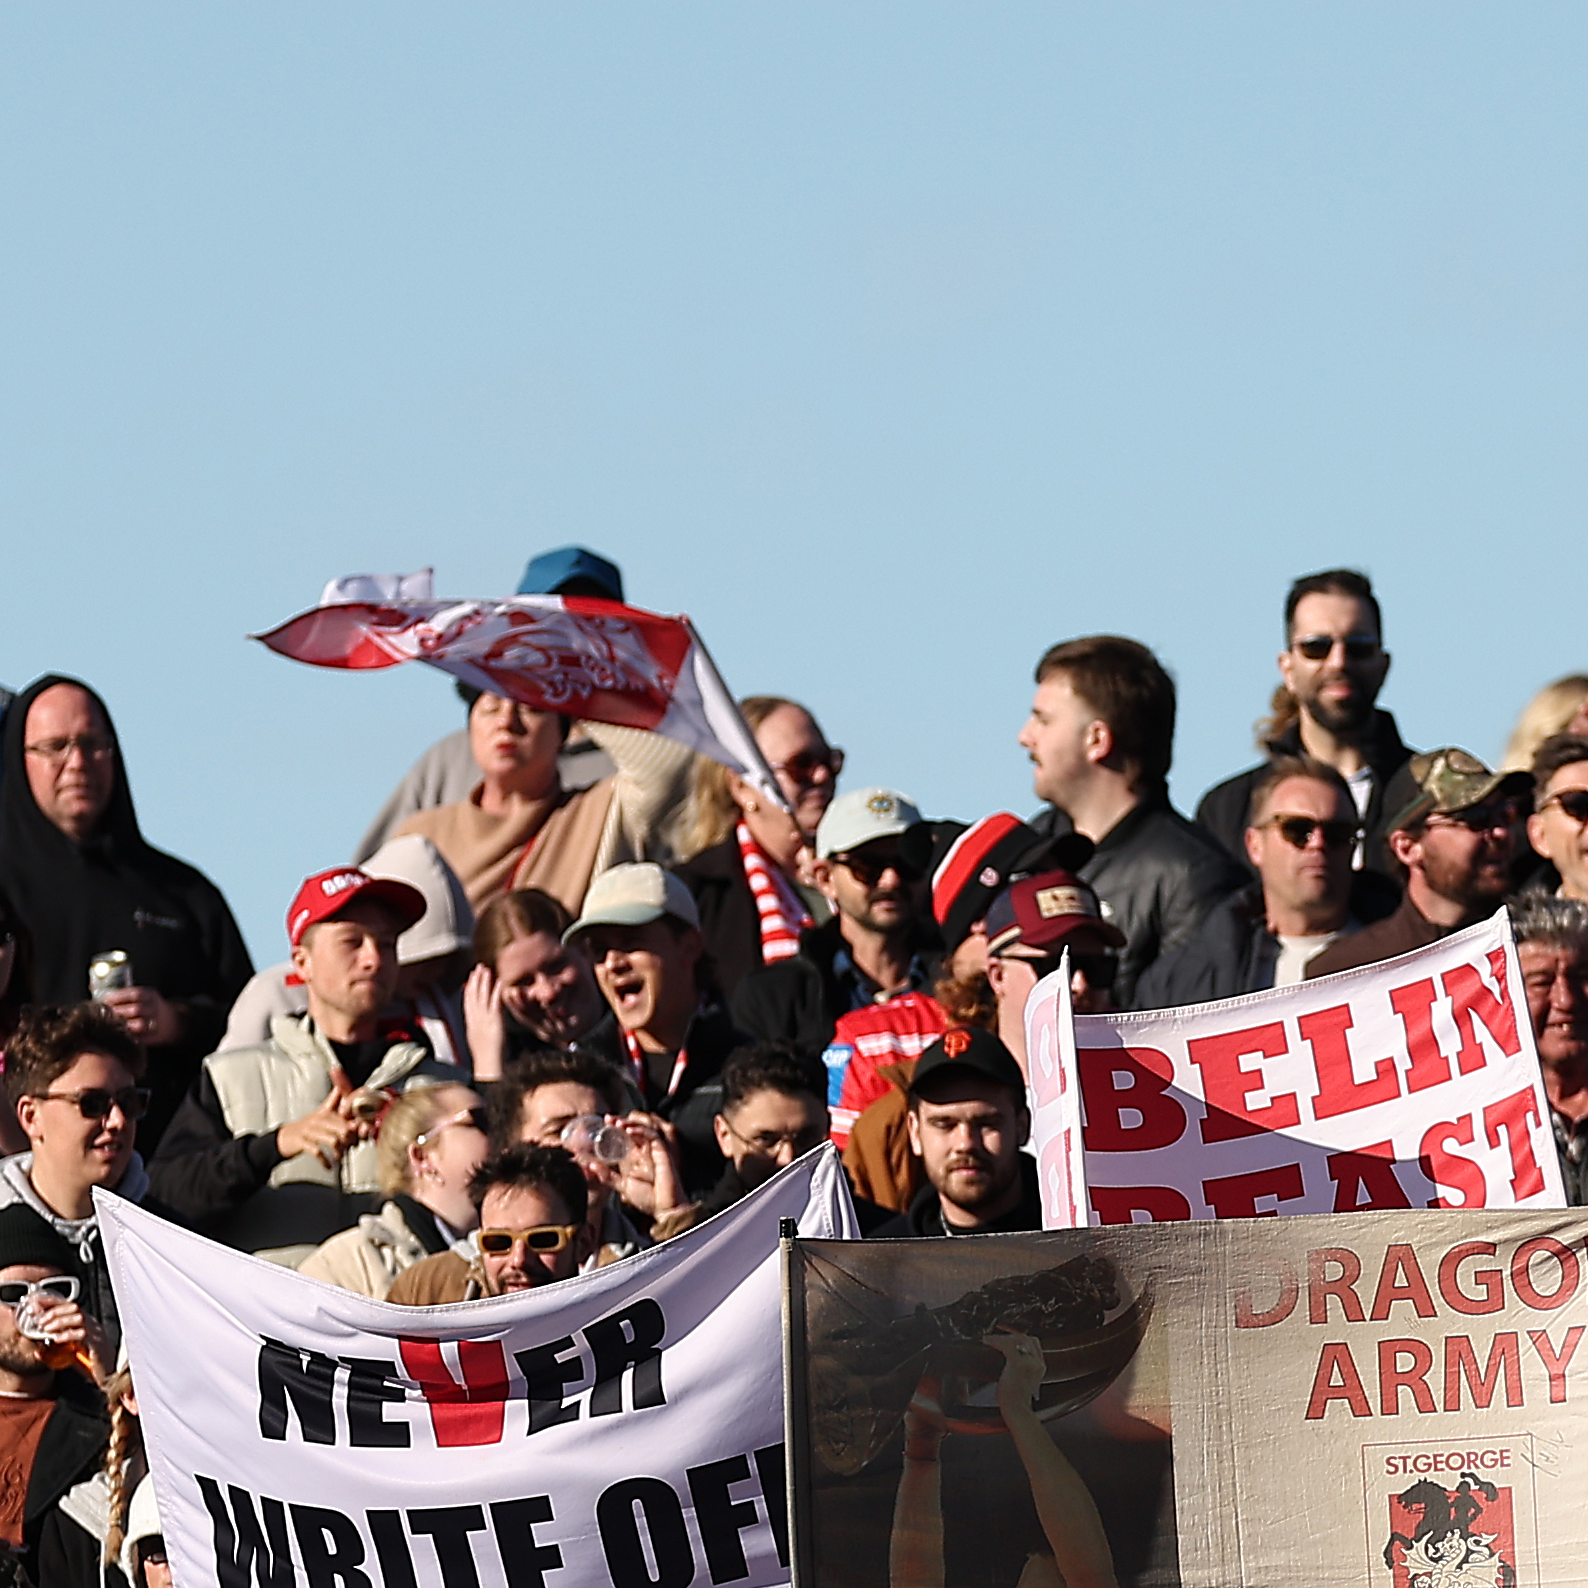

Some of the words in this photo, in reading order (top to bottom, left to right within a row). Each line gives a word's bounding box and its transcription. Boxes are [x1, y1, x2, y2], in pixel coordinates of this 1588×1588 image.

[1077, 948, 1525, 1154] BELIN
[257, 1297, 668, 1450] NEVER
[1305, 1325, 1587, 1421] ARMY
[1384, 1448, 1512, 1477] ST.GEORGE
